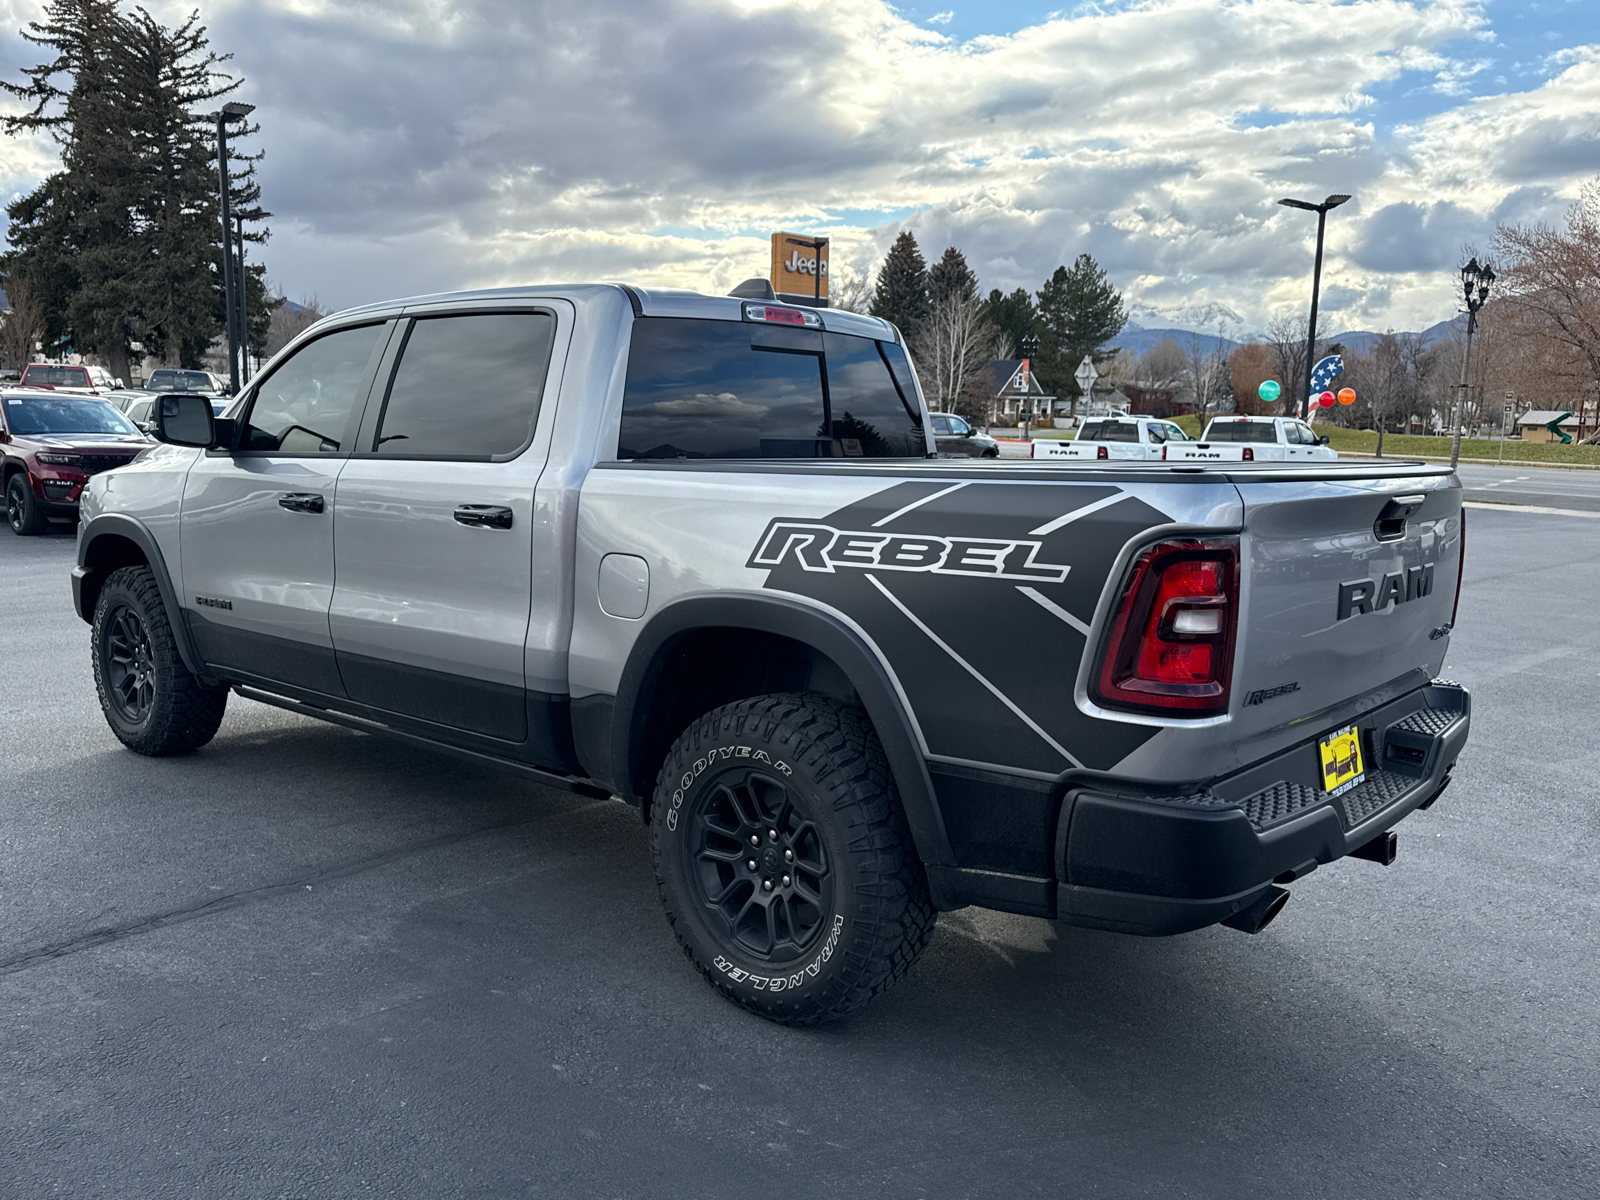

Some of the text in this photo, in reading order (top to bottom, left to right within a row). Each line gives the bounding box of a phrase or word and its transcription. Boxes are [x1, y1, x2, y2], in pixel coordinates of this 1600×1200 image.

[785, 250, 828, 277] Jeep
[751, 521, 1072, 584] REBEL
[1337, 562, 1434, 621] RAM
[1242, 681, 1302, 707] REBEL
[666, 745, 793, 831] GOODYEAR
[713, 914, 844, 992] WRANGLER
